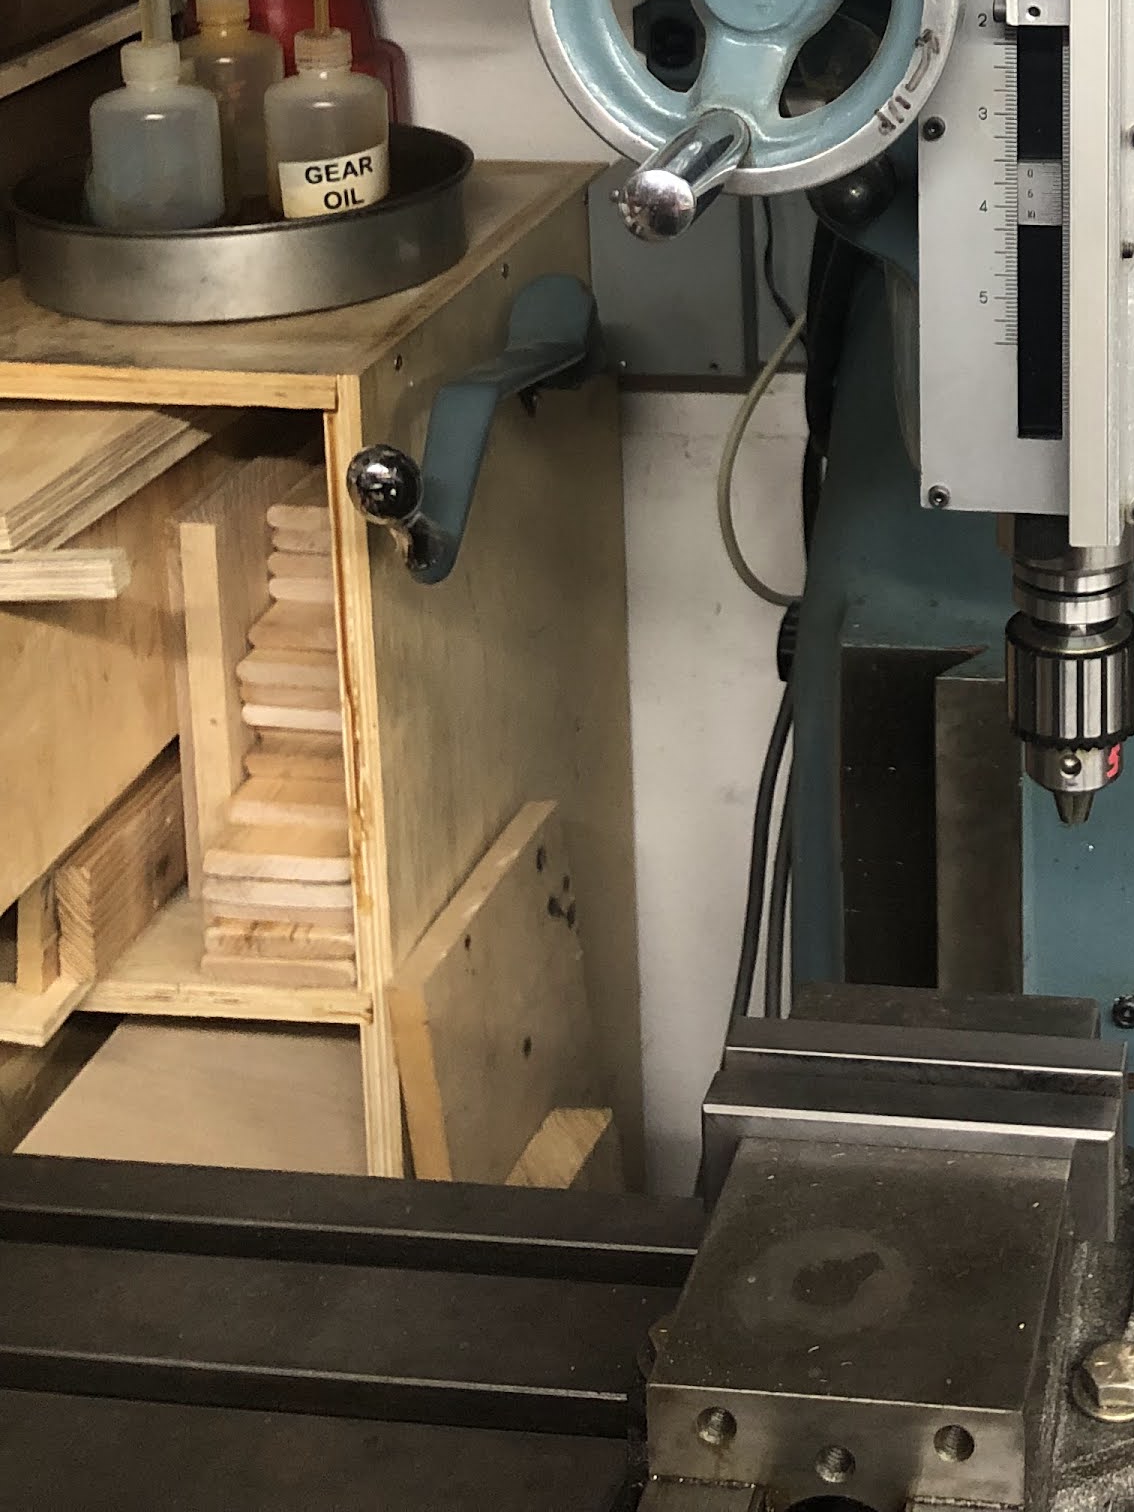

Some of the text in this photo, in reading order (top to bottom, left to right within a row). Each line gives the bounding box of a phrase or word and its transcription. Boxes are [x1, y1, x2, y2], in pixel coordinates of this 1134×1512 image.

[977, 13, 988, 28] 2
[978, 106, 988, 121] 3
[304, 156, 374, 185] GEAR
[323, 187, 365, 210] OIL
[979, 200, 989, 213] 4
[979, 291, 989, 304] 5
